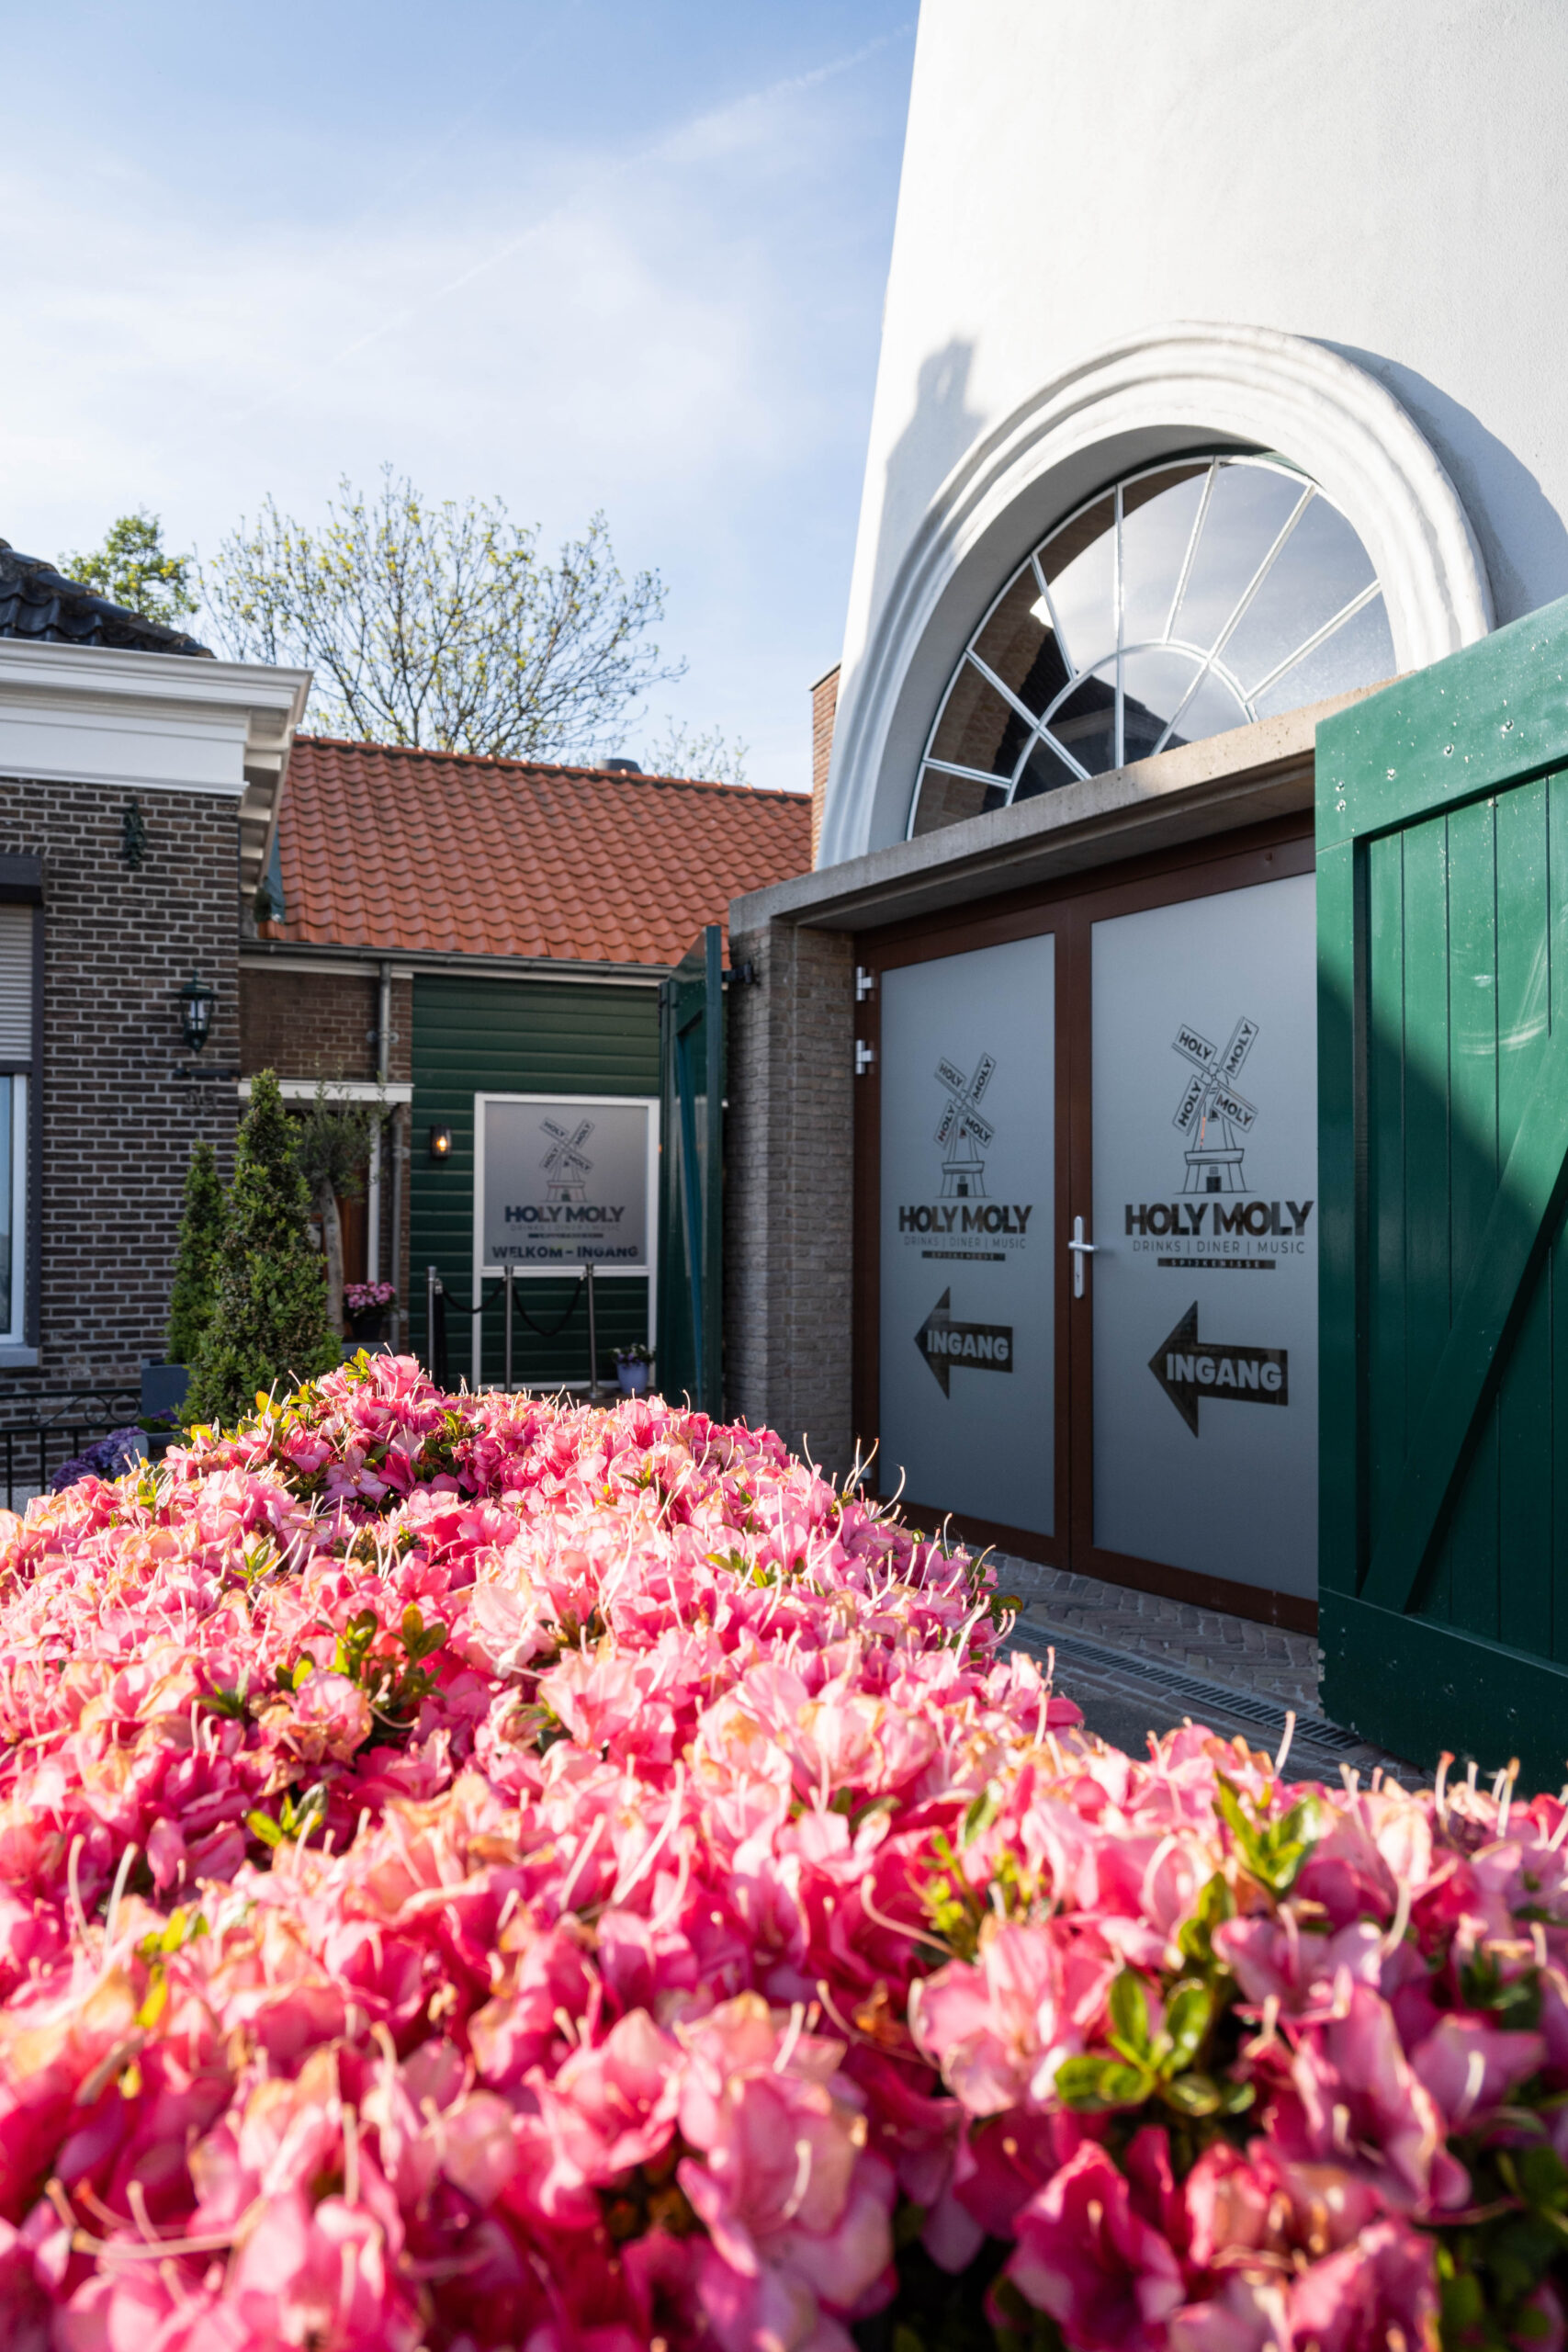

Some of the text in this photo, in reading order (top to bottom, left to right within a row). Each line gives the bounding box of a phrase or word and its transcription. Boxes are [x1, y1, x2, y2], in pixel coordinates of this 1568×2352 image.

[1178, 1031, 1213, 1061] HOLY
[1225, 1023, 1254, 1074] MOLY
[939, 1062, 964, 1088] HOLY
[972, 1058, 992, 1100] MOLY
[1177, 1080, 1202, 1127] HOLY
[1215, 1093, 1253, 1127] MOLY
[544, 1120, 565, 1138] HOLY
[575, 1123, 592, 1147] MOLY
[937, 1104, 956, 1143] HOLY
[965, 1115, 992, 1144] MOLY
[569, 1154, 592, 1172] MOLY
[504, 1205, 626, 1223] HOLY MOLY
[898, 1204, 1033, 1234] HOLY MOLY
[1124, 1200, 1314, 1237] HOLY MOLY
[492, 1245, 563, 1259] WELKOM
[577, 1245, 639, 1258] INGANG
[904, 1235, 940, 1247] DRINKS
[949, 1236, 981, 1248] DINER
[992, 1238, 1026, 1250] MUSIC
[1133, 1240, 1181, 1253] DRINKS
[1196, 1241, 1240, 1253] DINER
[1257, 1241, 1305, 1254] MUSIC
[927, 1329, 1010, 1363] INGANG
[1166, 1352, 1283, 1392] INGANG
